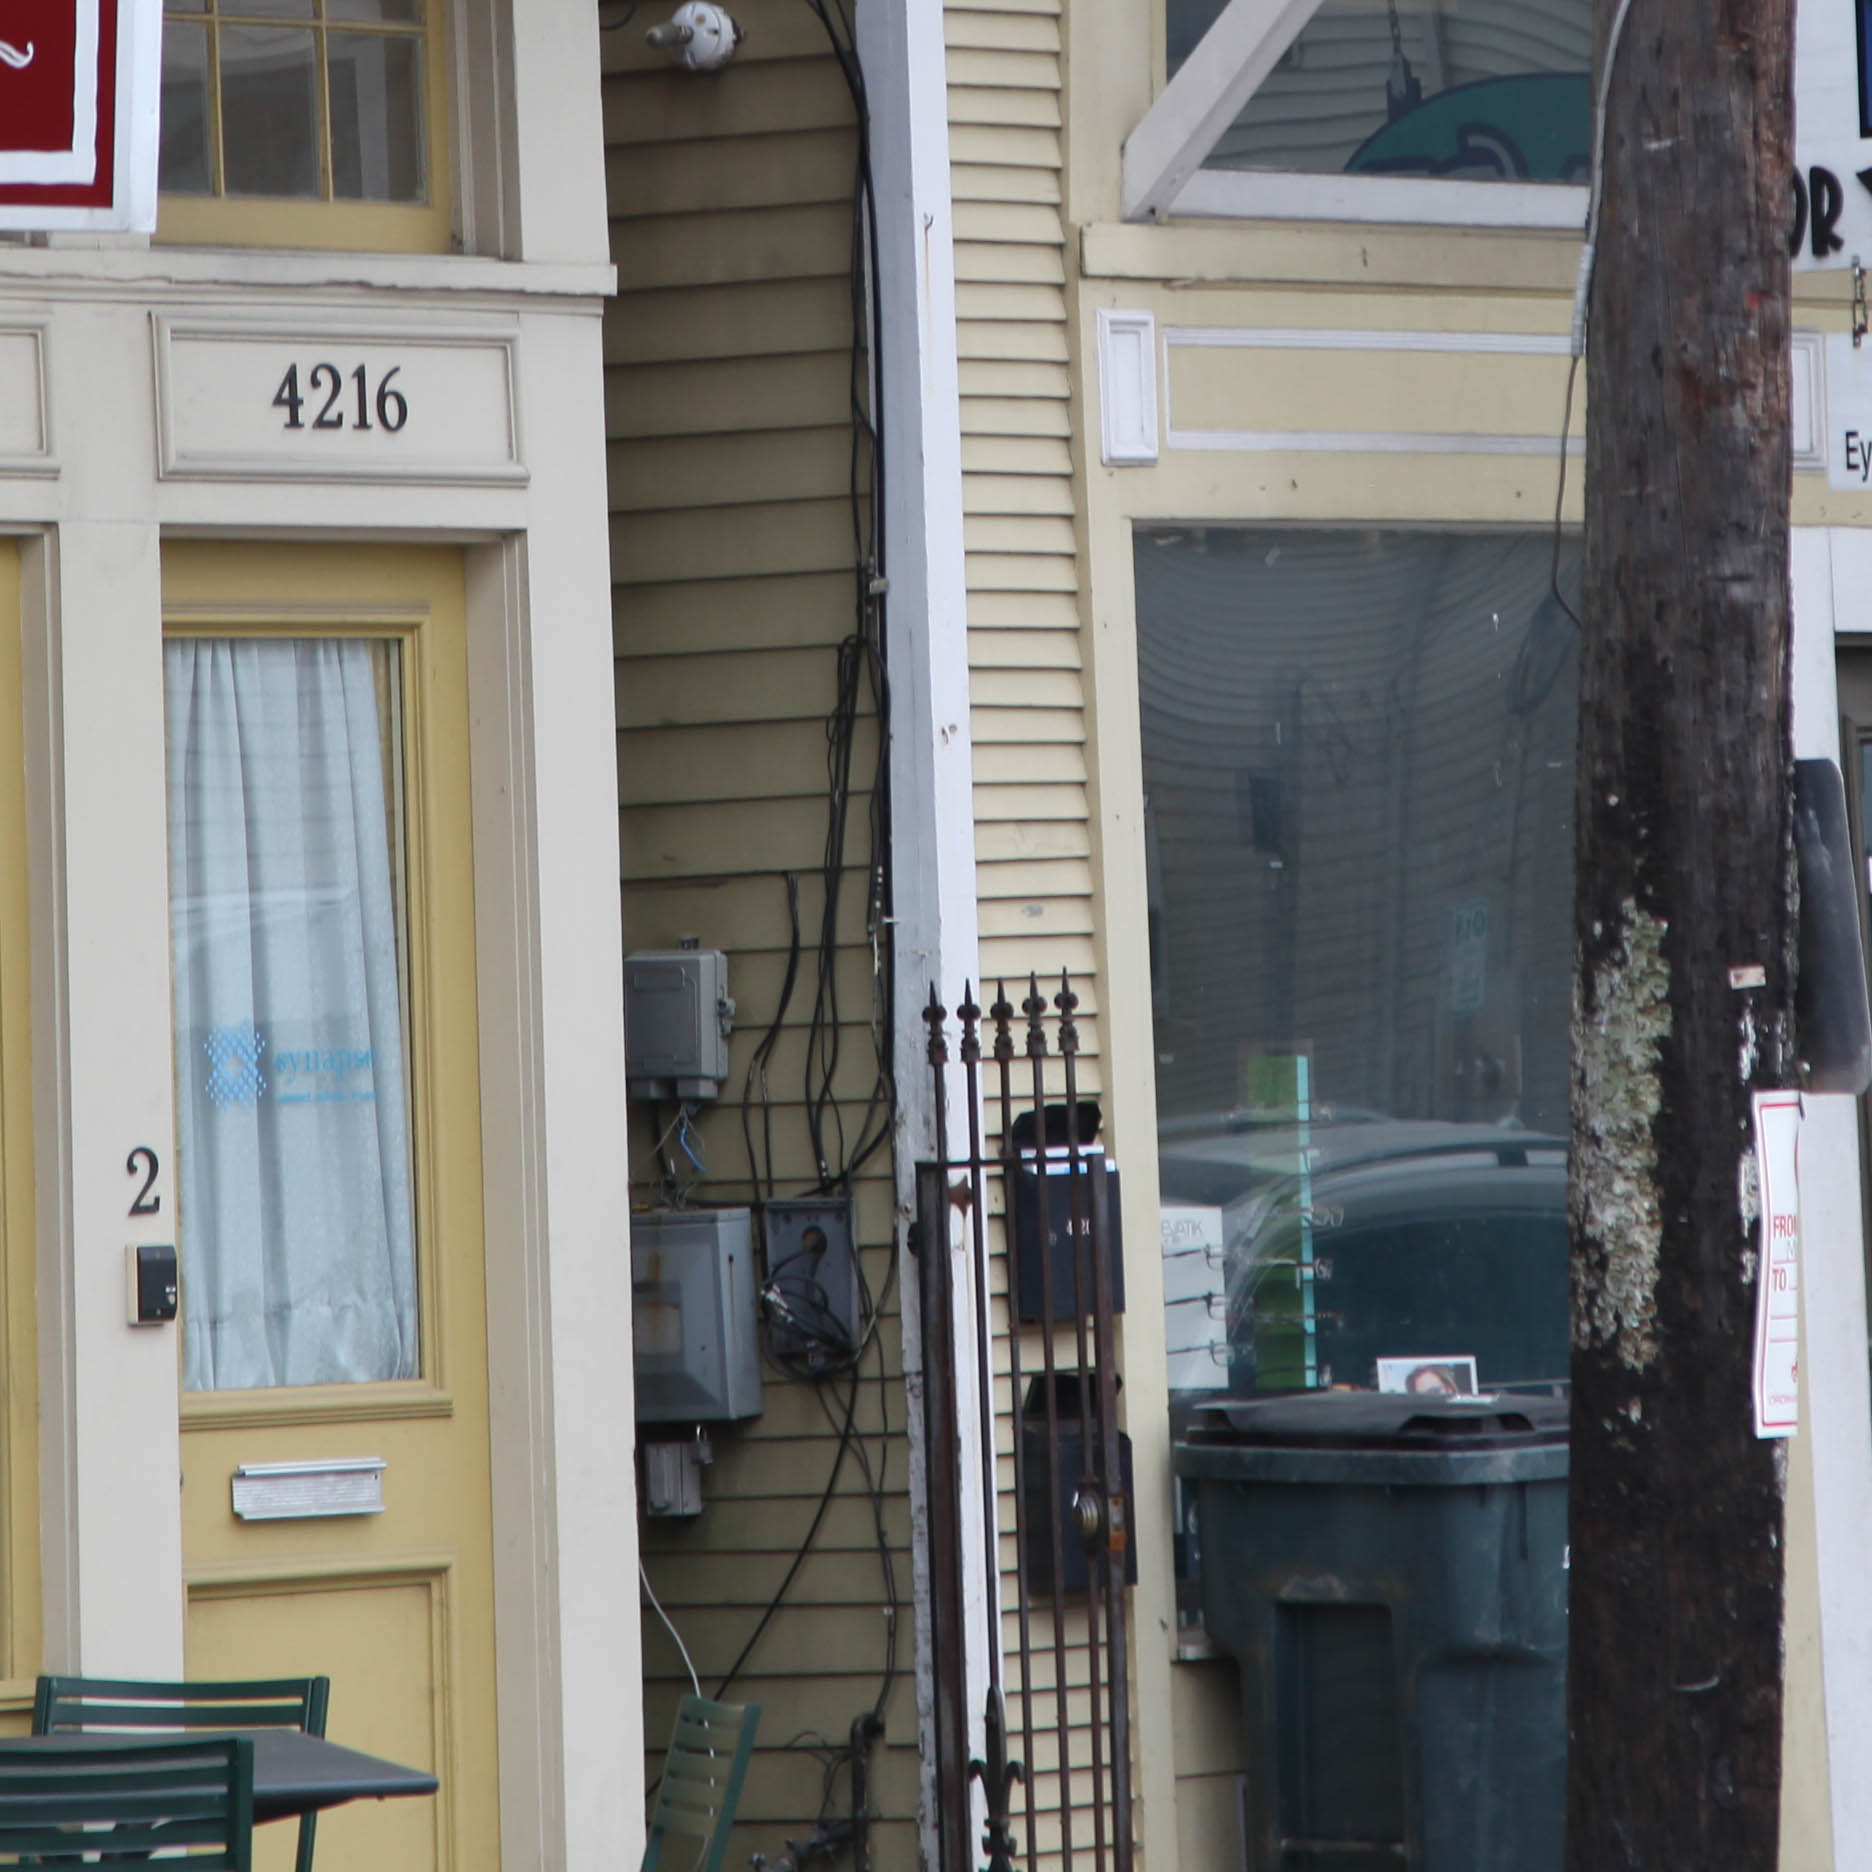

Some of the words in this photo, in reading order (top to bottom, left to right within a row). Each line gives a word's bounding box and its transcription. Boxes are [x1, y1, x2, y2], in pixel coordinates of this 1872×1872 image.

[1790, 166, 1845, 258] OR
[272, 361, 408, 433] 4216
[126, 1145, 161, 1217] 2
